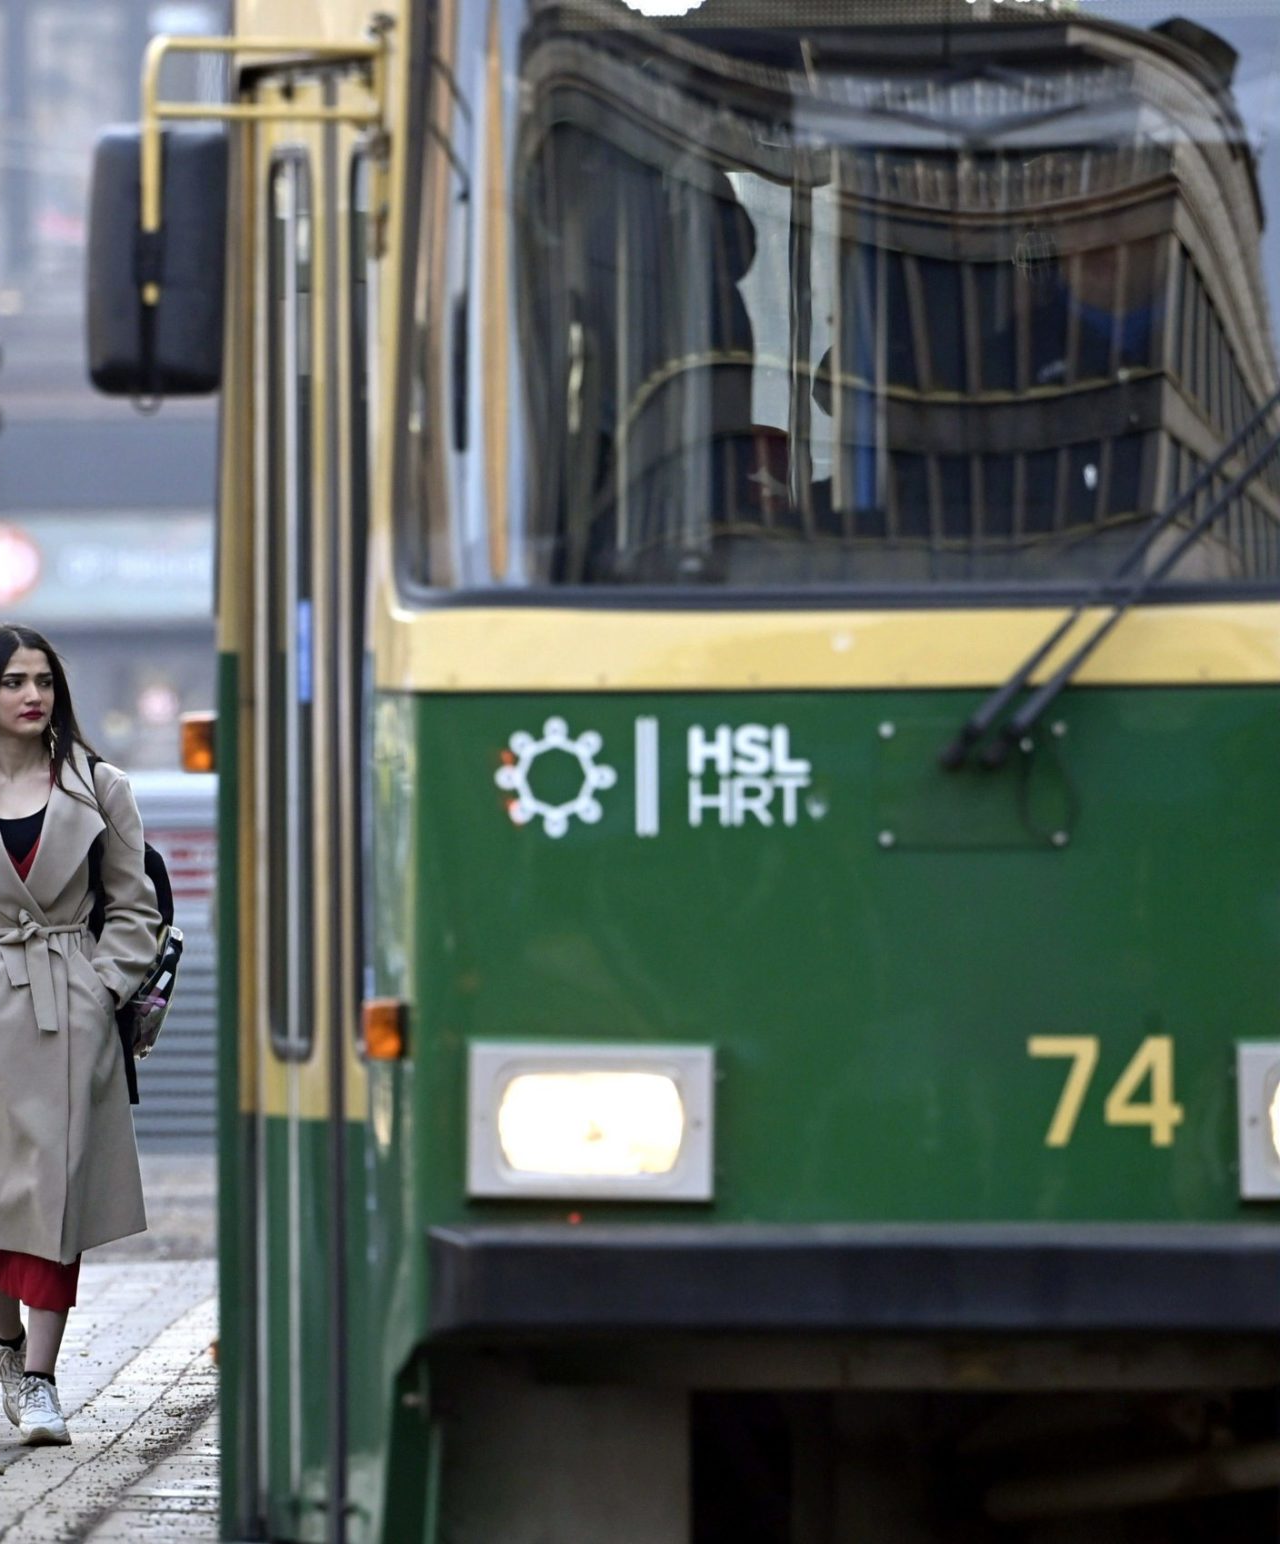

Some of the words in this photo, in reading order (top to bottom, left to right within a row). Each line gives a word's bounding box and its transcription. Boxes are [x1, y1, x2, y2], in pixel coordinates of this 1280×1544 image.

[687, 724, 811, 776] HSL
[687, 775, 811, 828] HRT
[1027, 1034, 1185, 1148] 74
